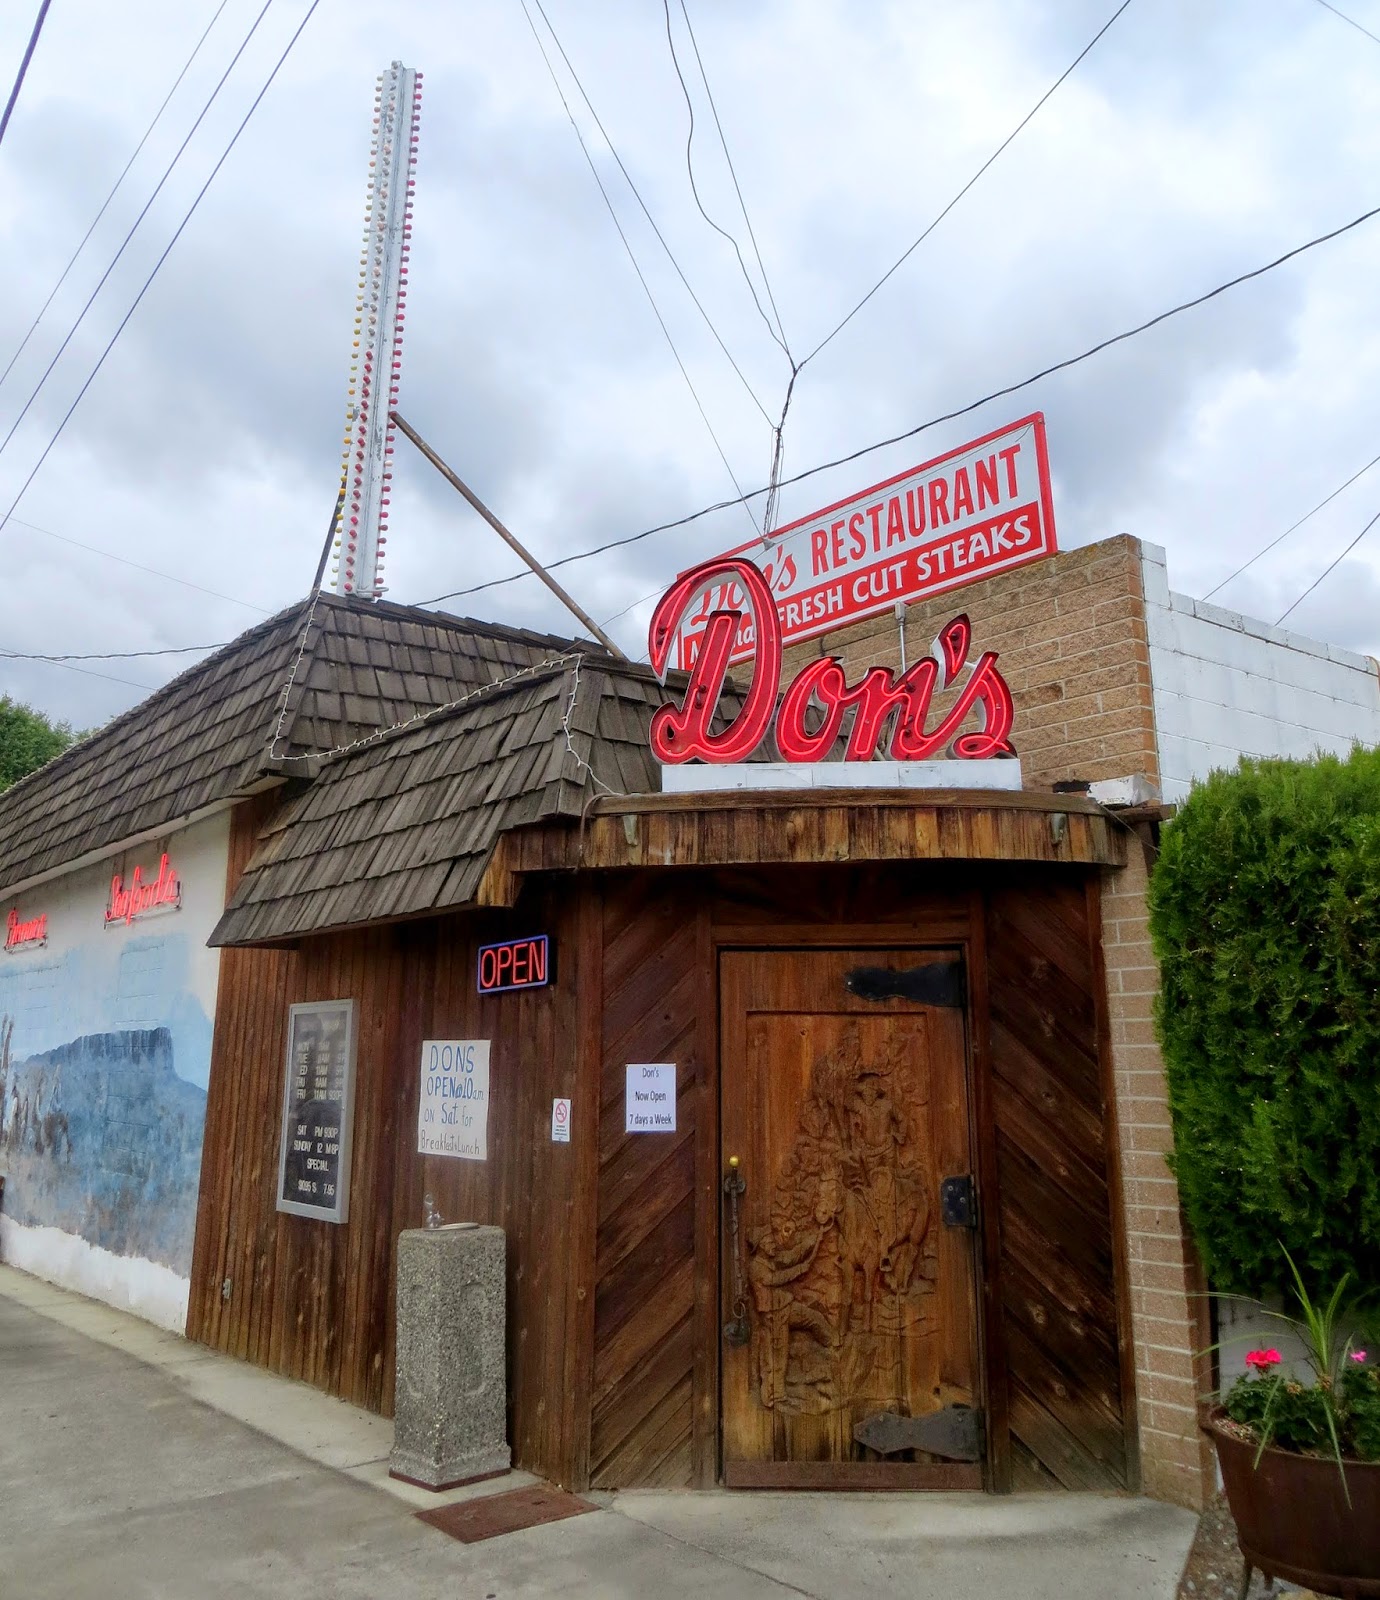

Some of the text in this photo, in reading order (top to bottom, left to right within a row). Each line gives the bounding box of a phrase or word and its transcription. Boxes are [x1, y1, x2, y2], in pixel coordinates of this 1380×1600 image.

[811, 443, 1021, 577] RESTAURANT
[777, 514, 1032, 629] FRESH CUT STEAKS
[649, 557, 1019, 766] Don's
[480, 940, 545, 988] OPEN
[429, 1045, 475, 1073] DONS
[642, 1067, 660, 1078] Don's
[635, 1090, 666, 1103] Now Open
[424, 1108, 435, 1122] ON
[462, 1105, 473, 1127] for
[629, 1113, 672, 1126] 7 days a Week
[297, 1124, 307, 1136] SAT
[306, 1158, 329, 1171] SPECIAL
